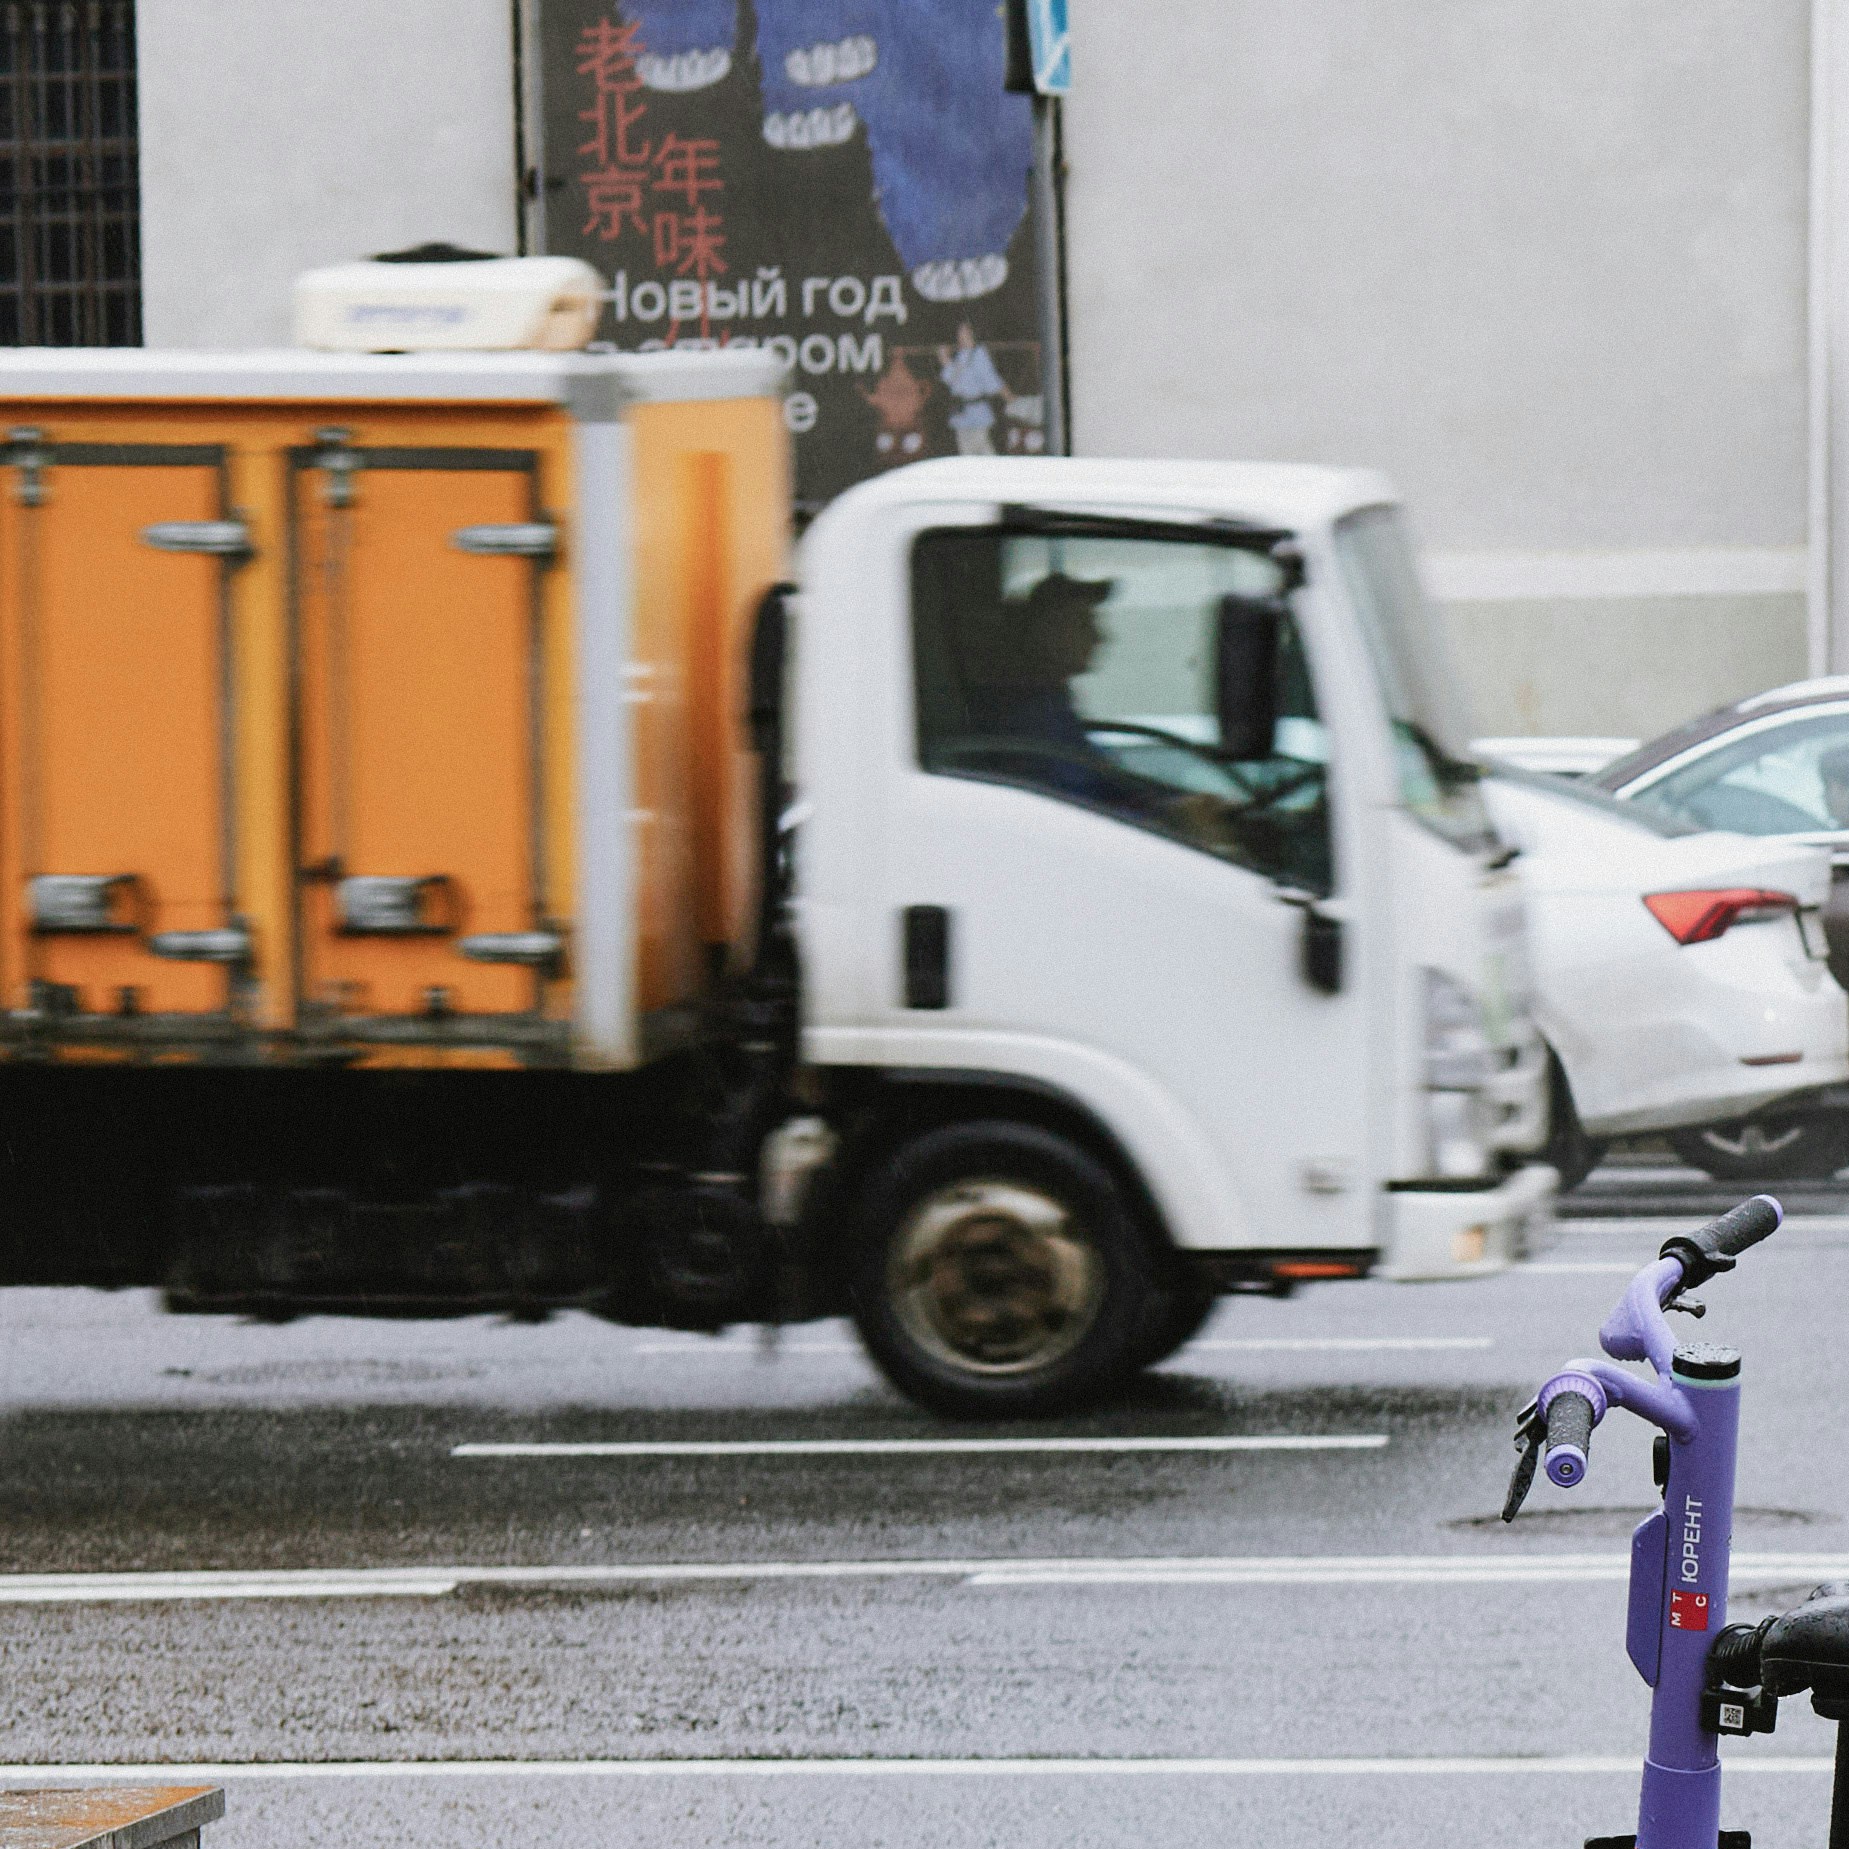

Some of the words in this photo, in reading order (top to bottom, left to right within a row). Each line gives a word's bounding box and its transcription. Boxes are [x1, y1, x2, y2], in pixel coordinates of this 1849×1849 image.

[575, 19, 652, 241] 老北京
[801, 274, 908, 326] год
[1681, 1494, 1703, 1584] ЮРЕНТ
